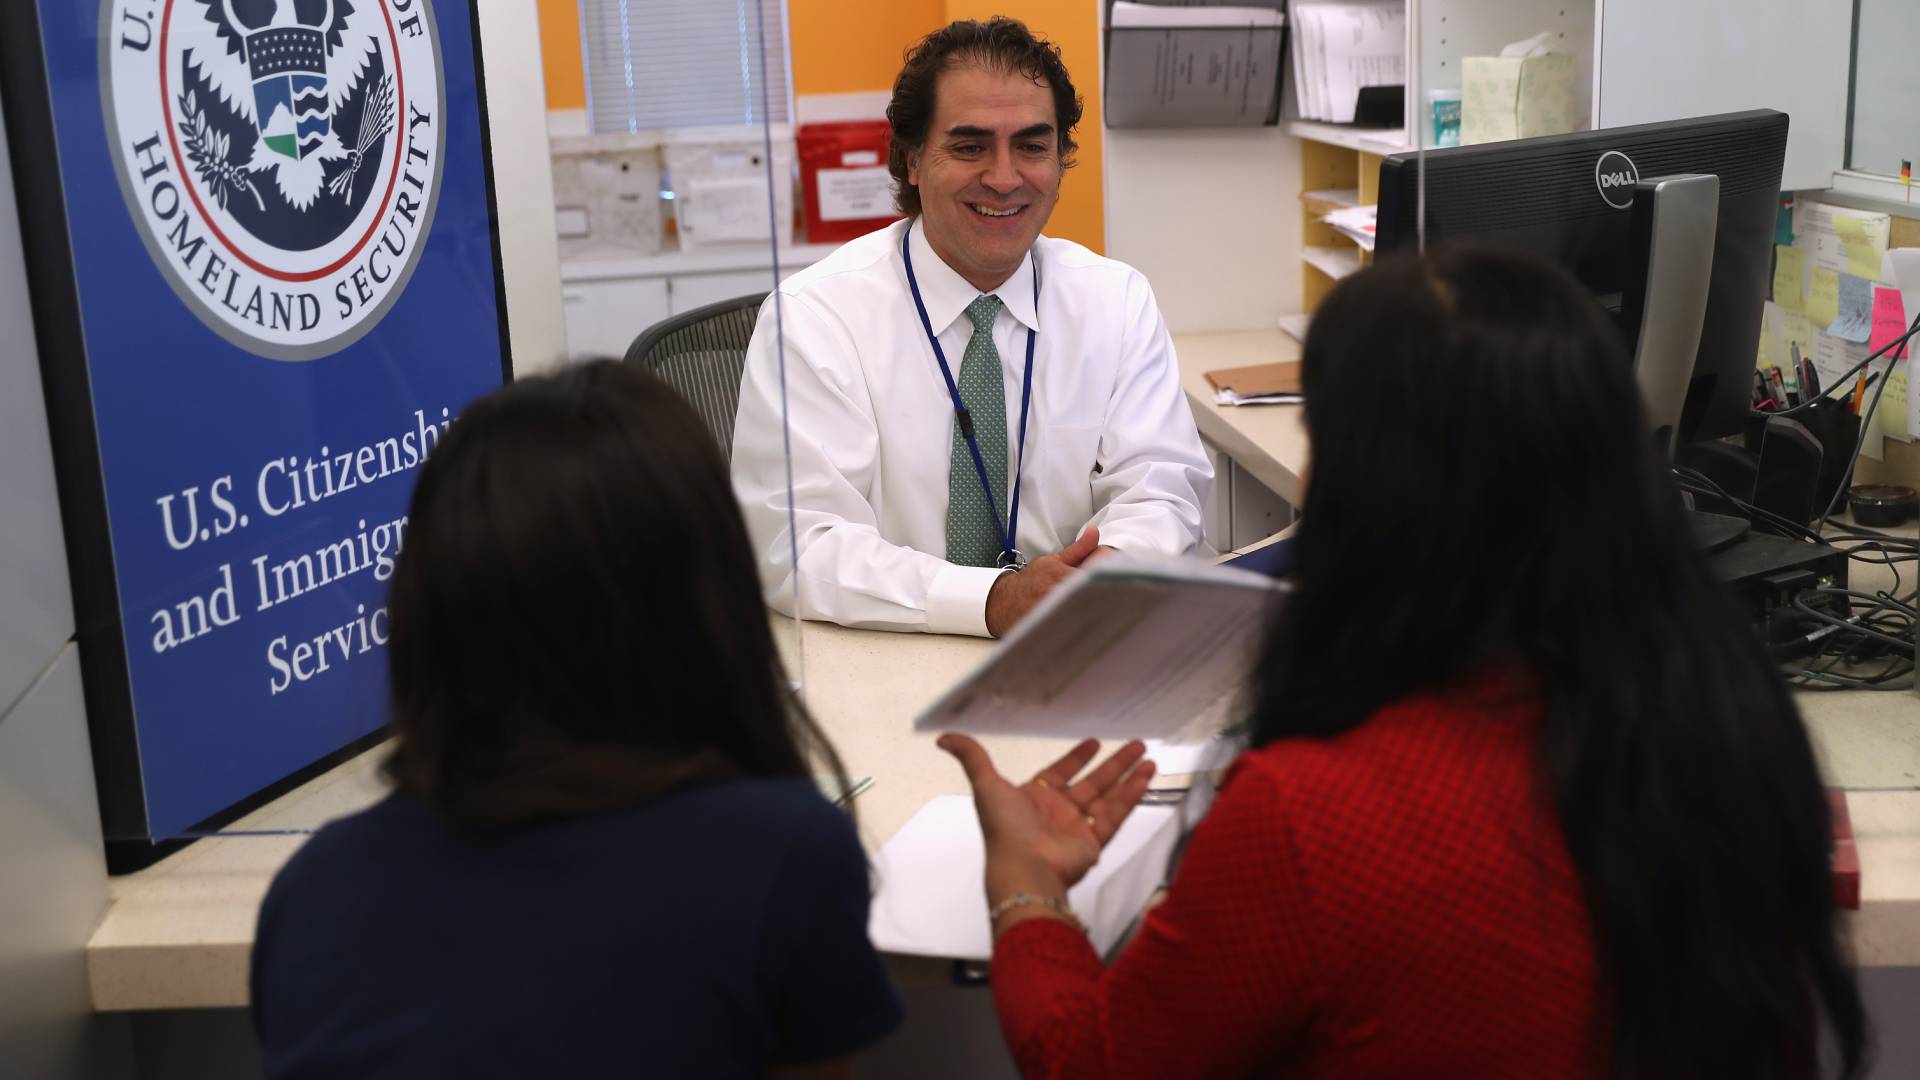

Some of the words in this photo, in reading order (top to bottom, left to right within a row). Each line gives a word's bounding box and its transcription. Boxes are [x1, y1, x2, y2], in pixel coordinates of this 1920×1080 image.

[121, 0, 157, 52] U.
[131, 131, 321, 332] HOMELAND
[335, 100, 431, 320] SECURITY
[1600, 171, 1635, 188] DELL
[156, 474, 249, 551] U.S.
[257, 407, 459, 517] Citizenshi
[151, 563, 240, 653] and
[252, 515, 409, 612] Immigr
[267, 603, 390, 695] Servic
